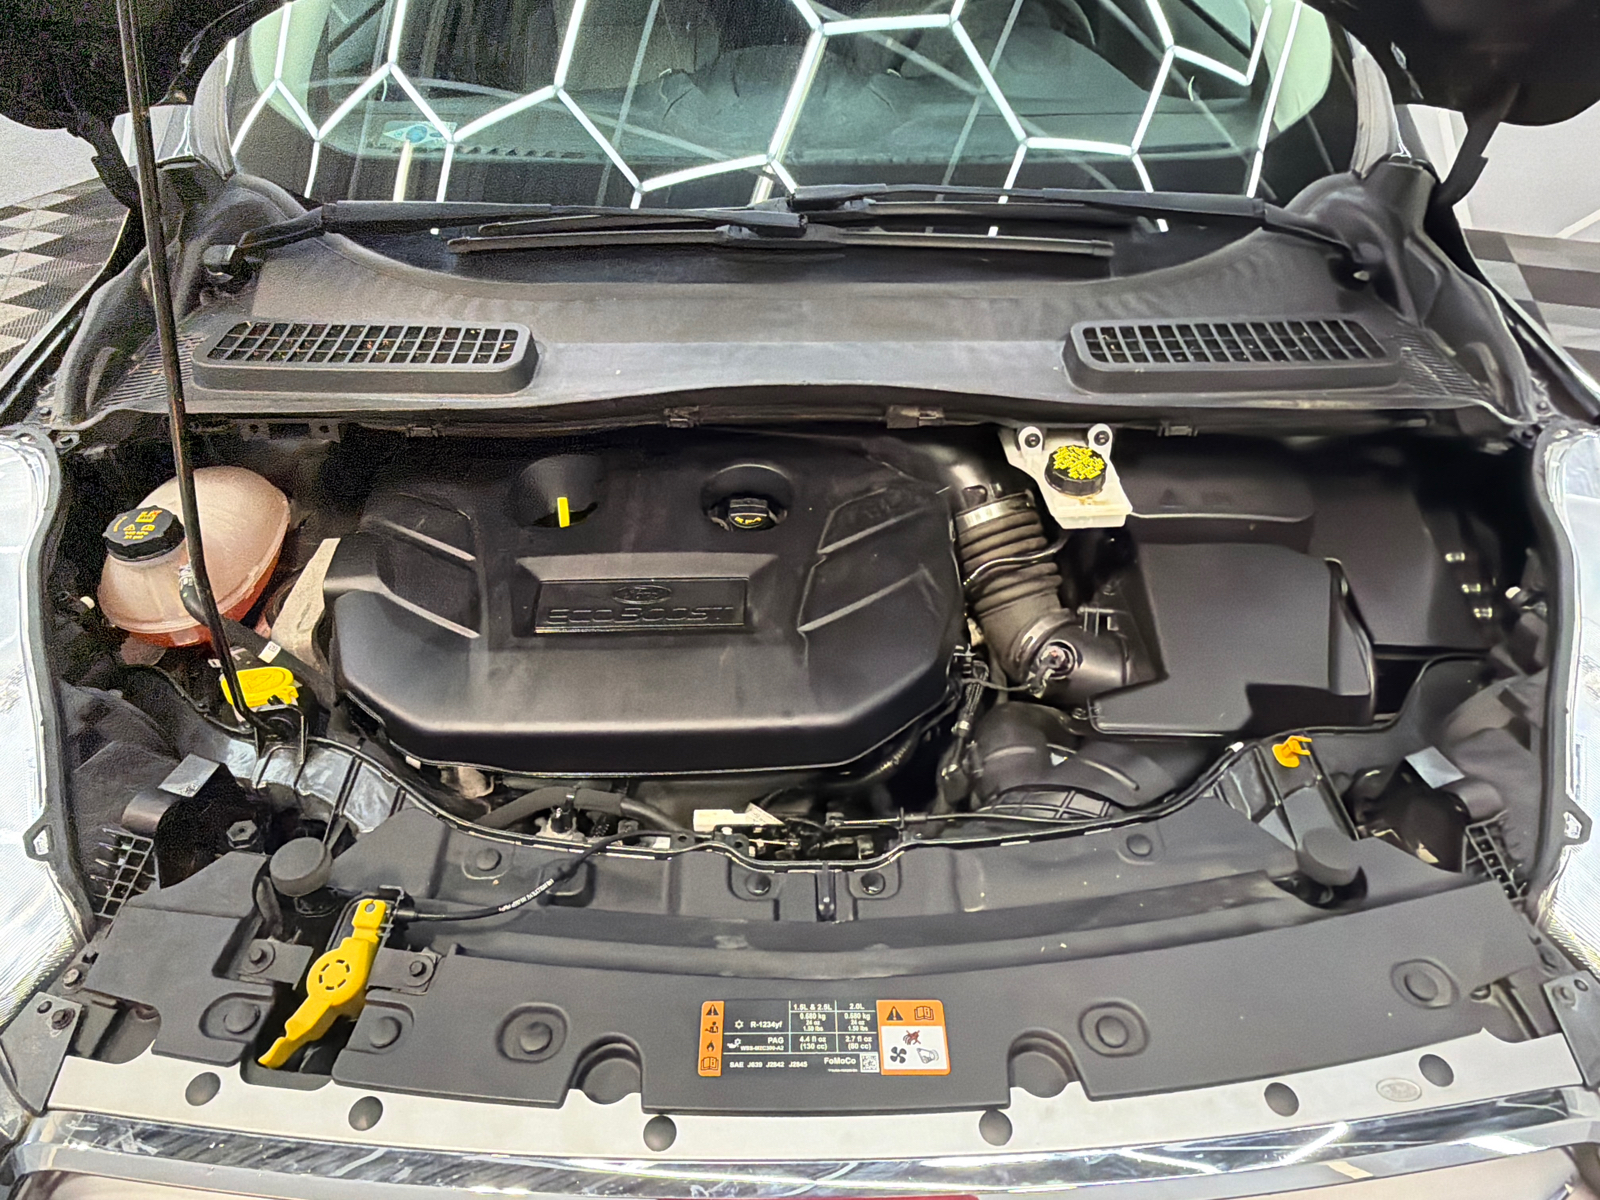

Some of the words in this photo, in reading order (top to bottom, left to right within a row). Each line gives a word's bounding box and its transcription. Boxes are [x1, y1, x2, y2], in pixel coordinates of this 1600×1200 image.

[810, 1003, 816, 1011] &
[818, 1012, 827, 1021] kg
[862, 1012, 871, 1021] kg
[750, 1021, 783, 1029] R-1234yf
[800, 1043, 815, 1051] (130
[816, 1043, 828, 1051] cc)
[860, 1043, 872, 1051] cc)
[823, 1056, 857, 1065] FoMoCo
